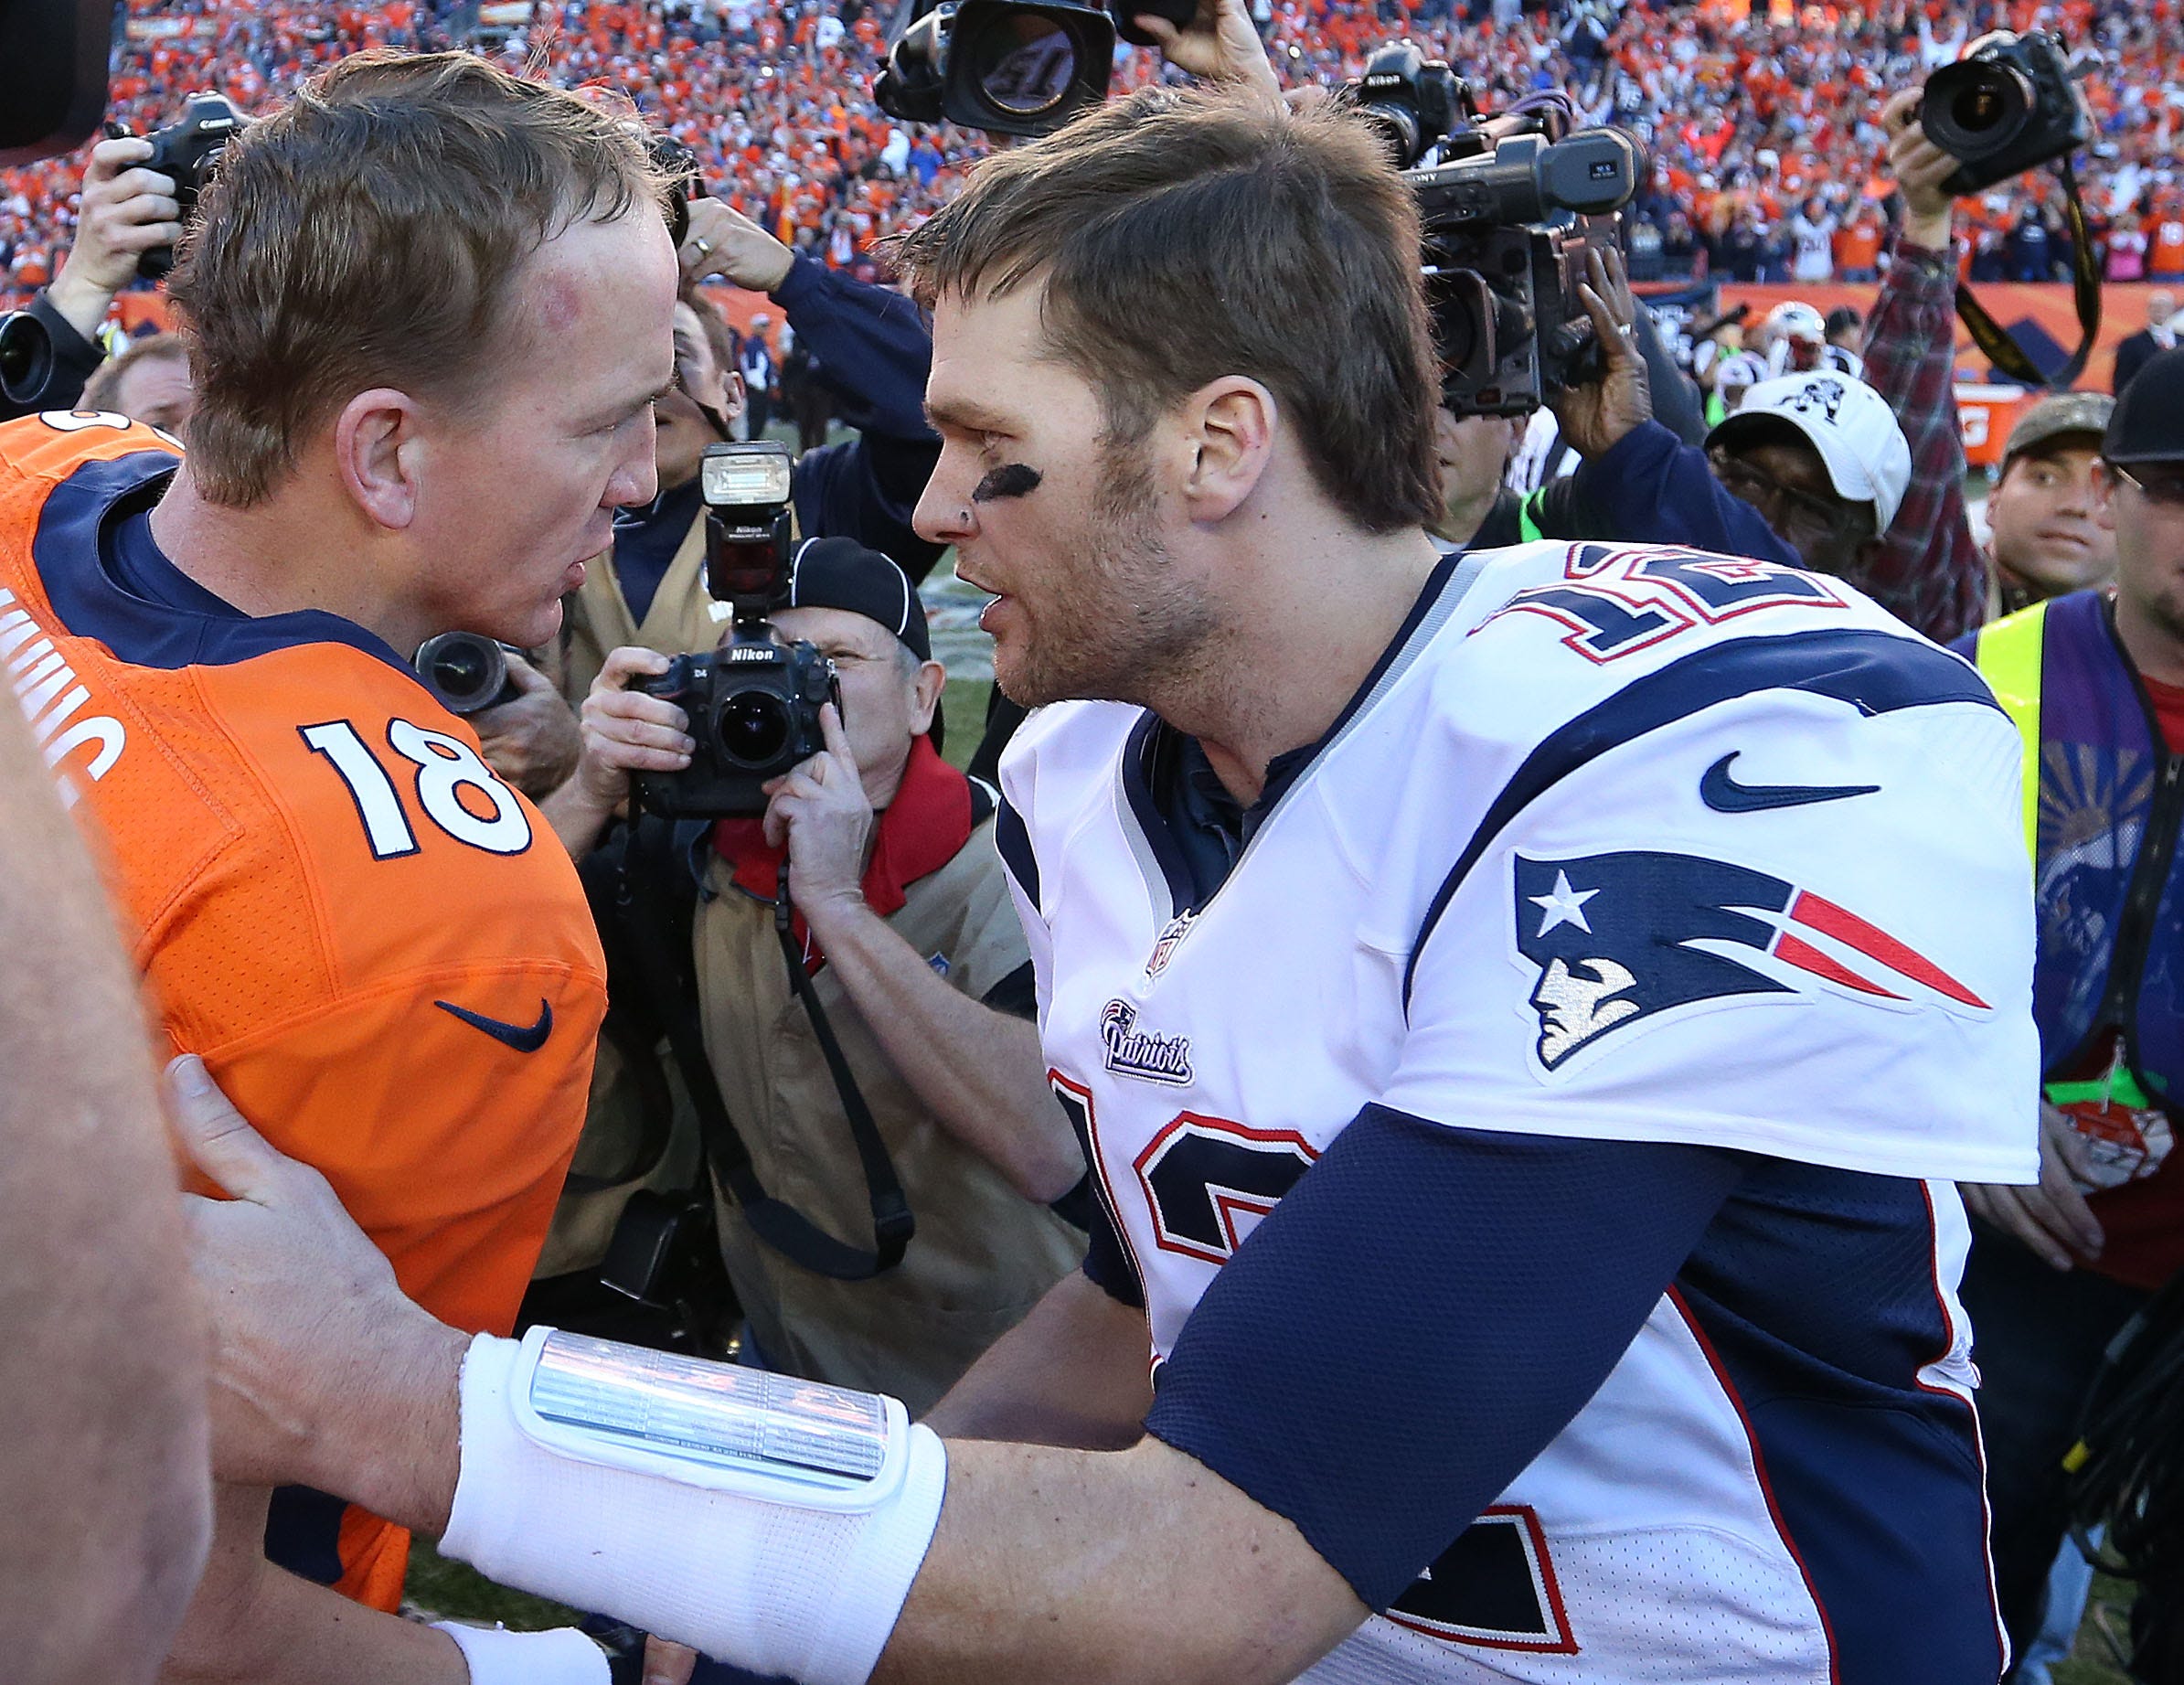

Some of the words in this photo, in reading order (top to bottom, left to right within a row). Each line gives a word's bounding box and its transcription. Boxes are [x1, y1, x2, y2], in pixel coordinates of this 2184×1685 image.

[1465, 542, 1851, 667] 12
[731, 648, 774, 661] Nikon
[296, 717, 533, 862] 18
[1105, 1028, 1192, 1082] Patriots
